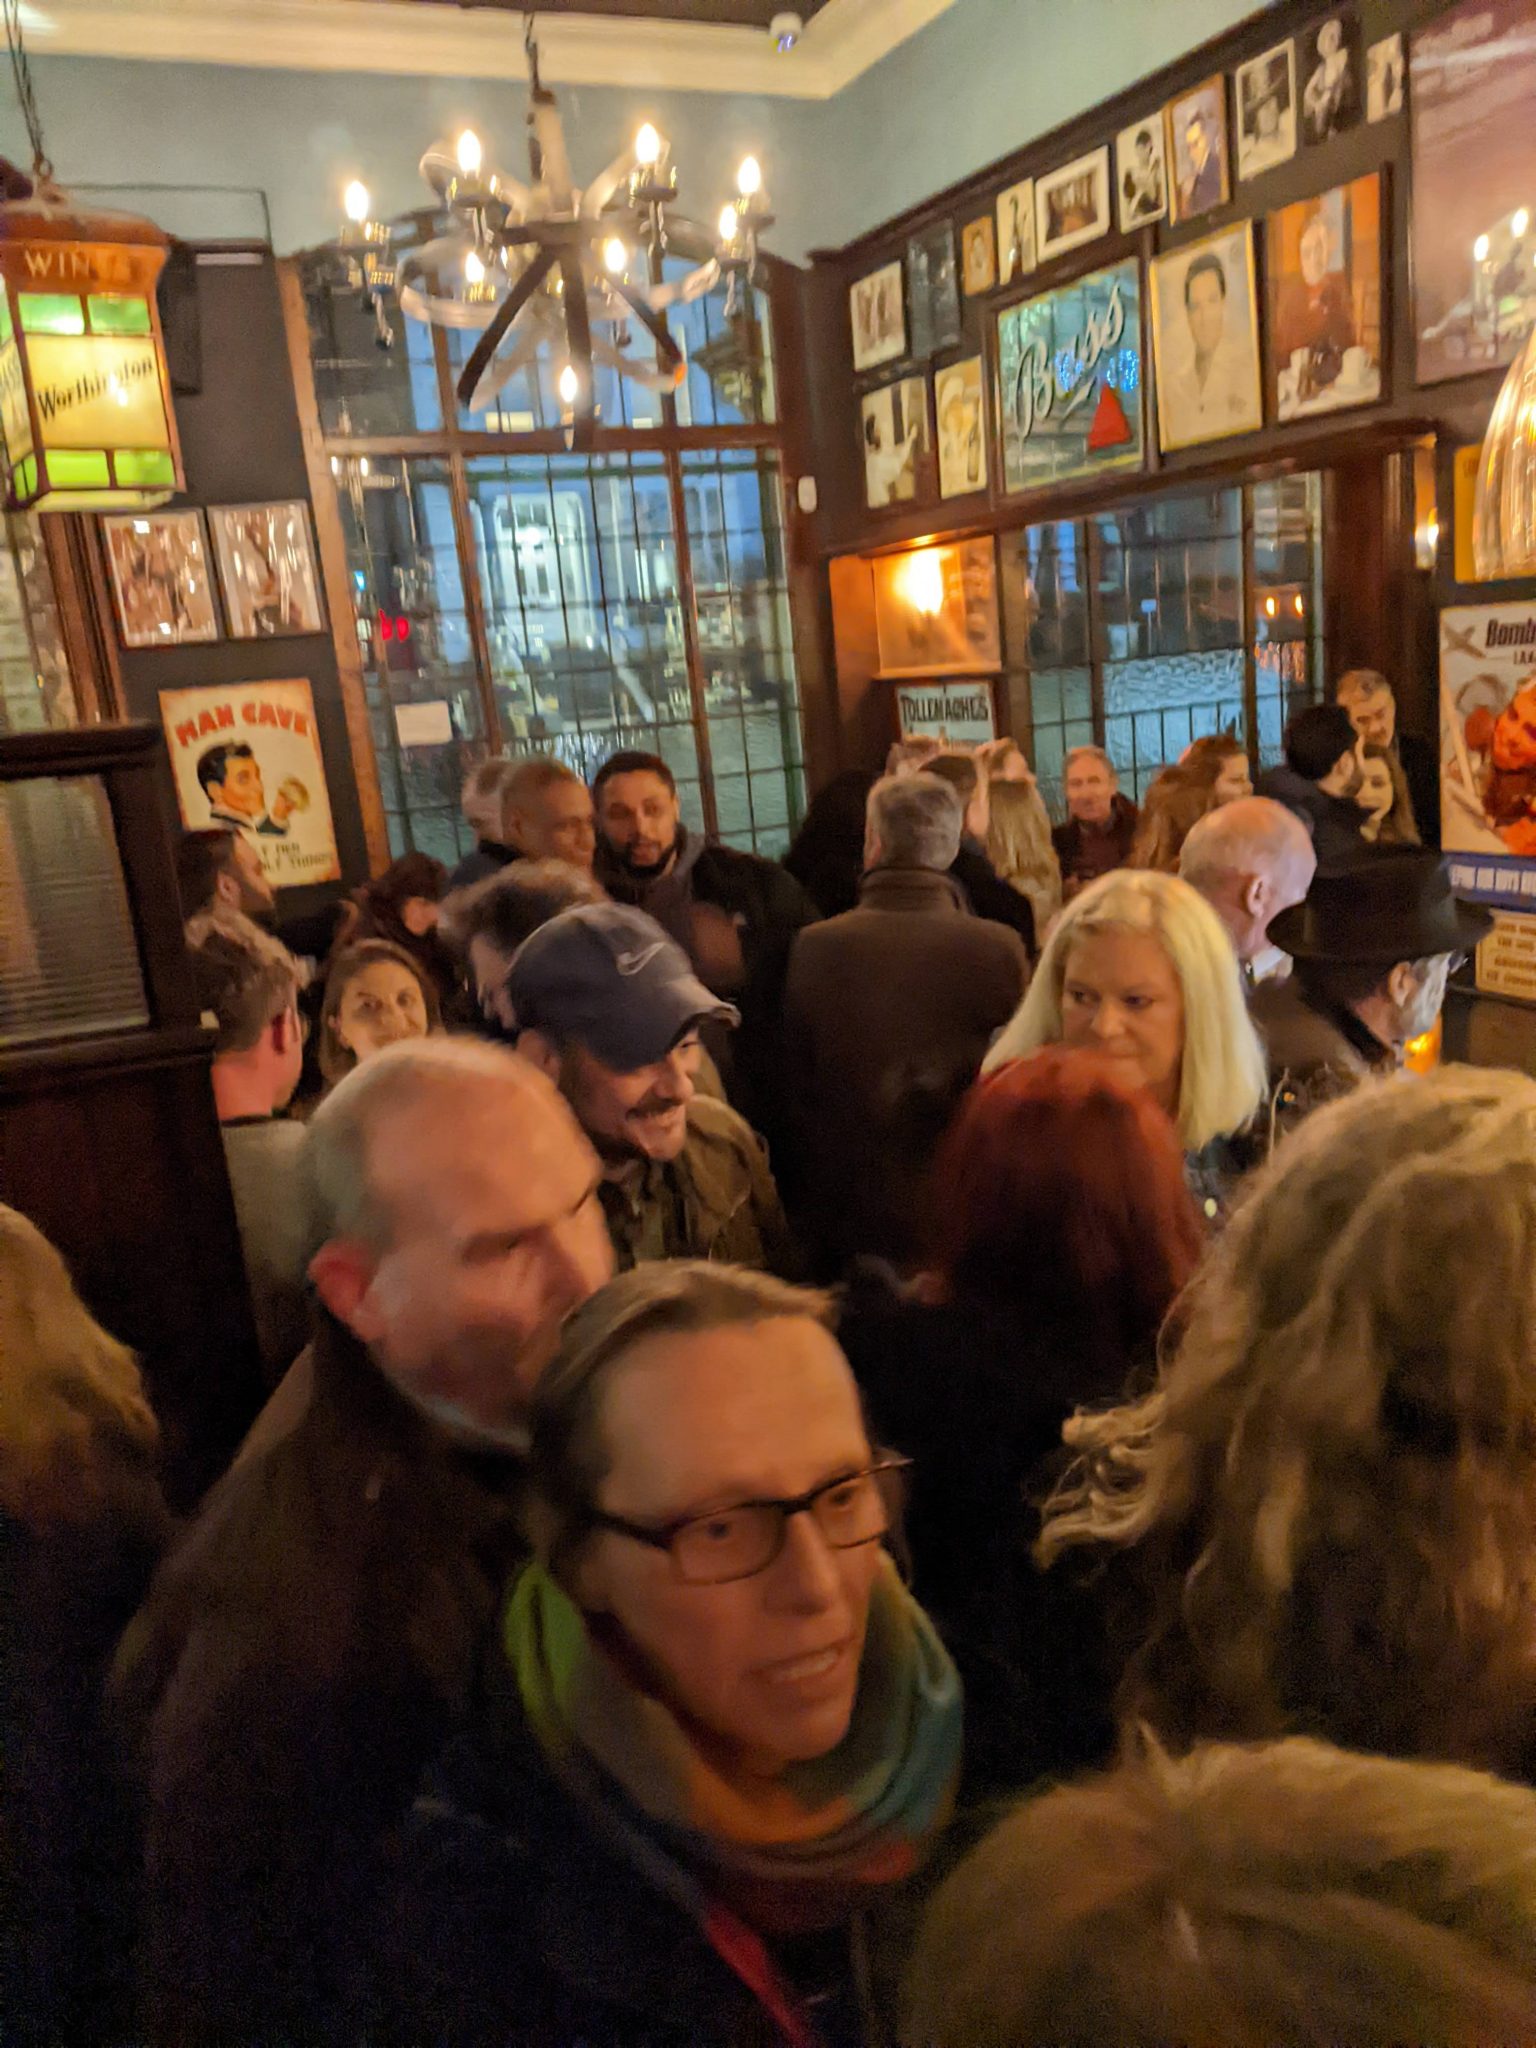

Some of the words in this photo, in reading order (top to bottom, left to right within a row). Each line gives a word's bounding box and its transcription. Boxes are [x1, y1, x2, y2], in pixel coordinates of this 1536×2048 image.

[36, 357, 153, 422] Worthinton
[174, 703, 236, 748] MAN
[241, 702, 309, 738] CAVE
